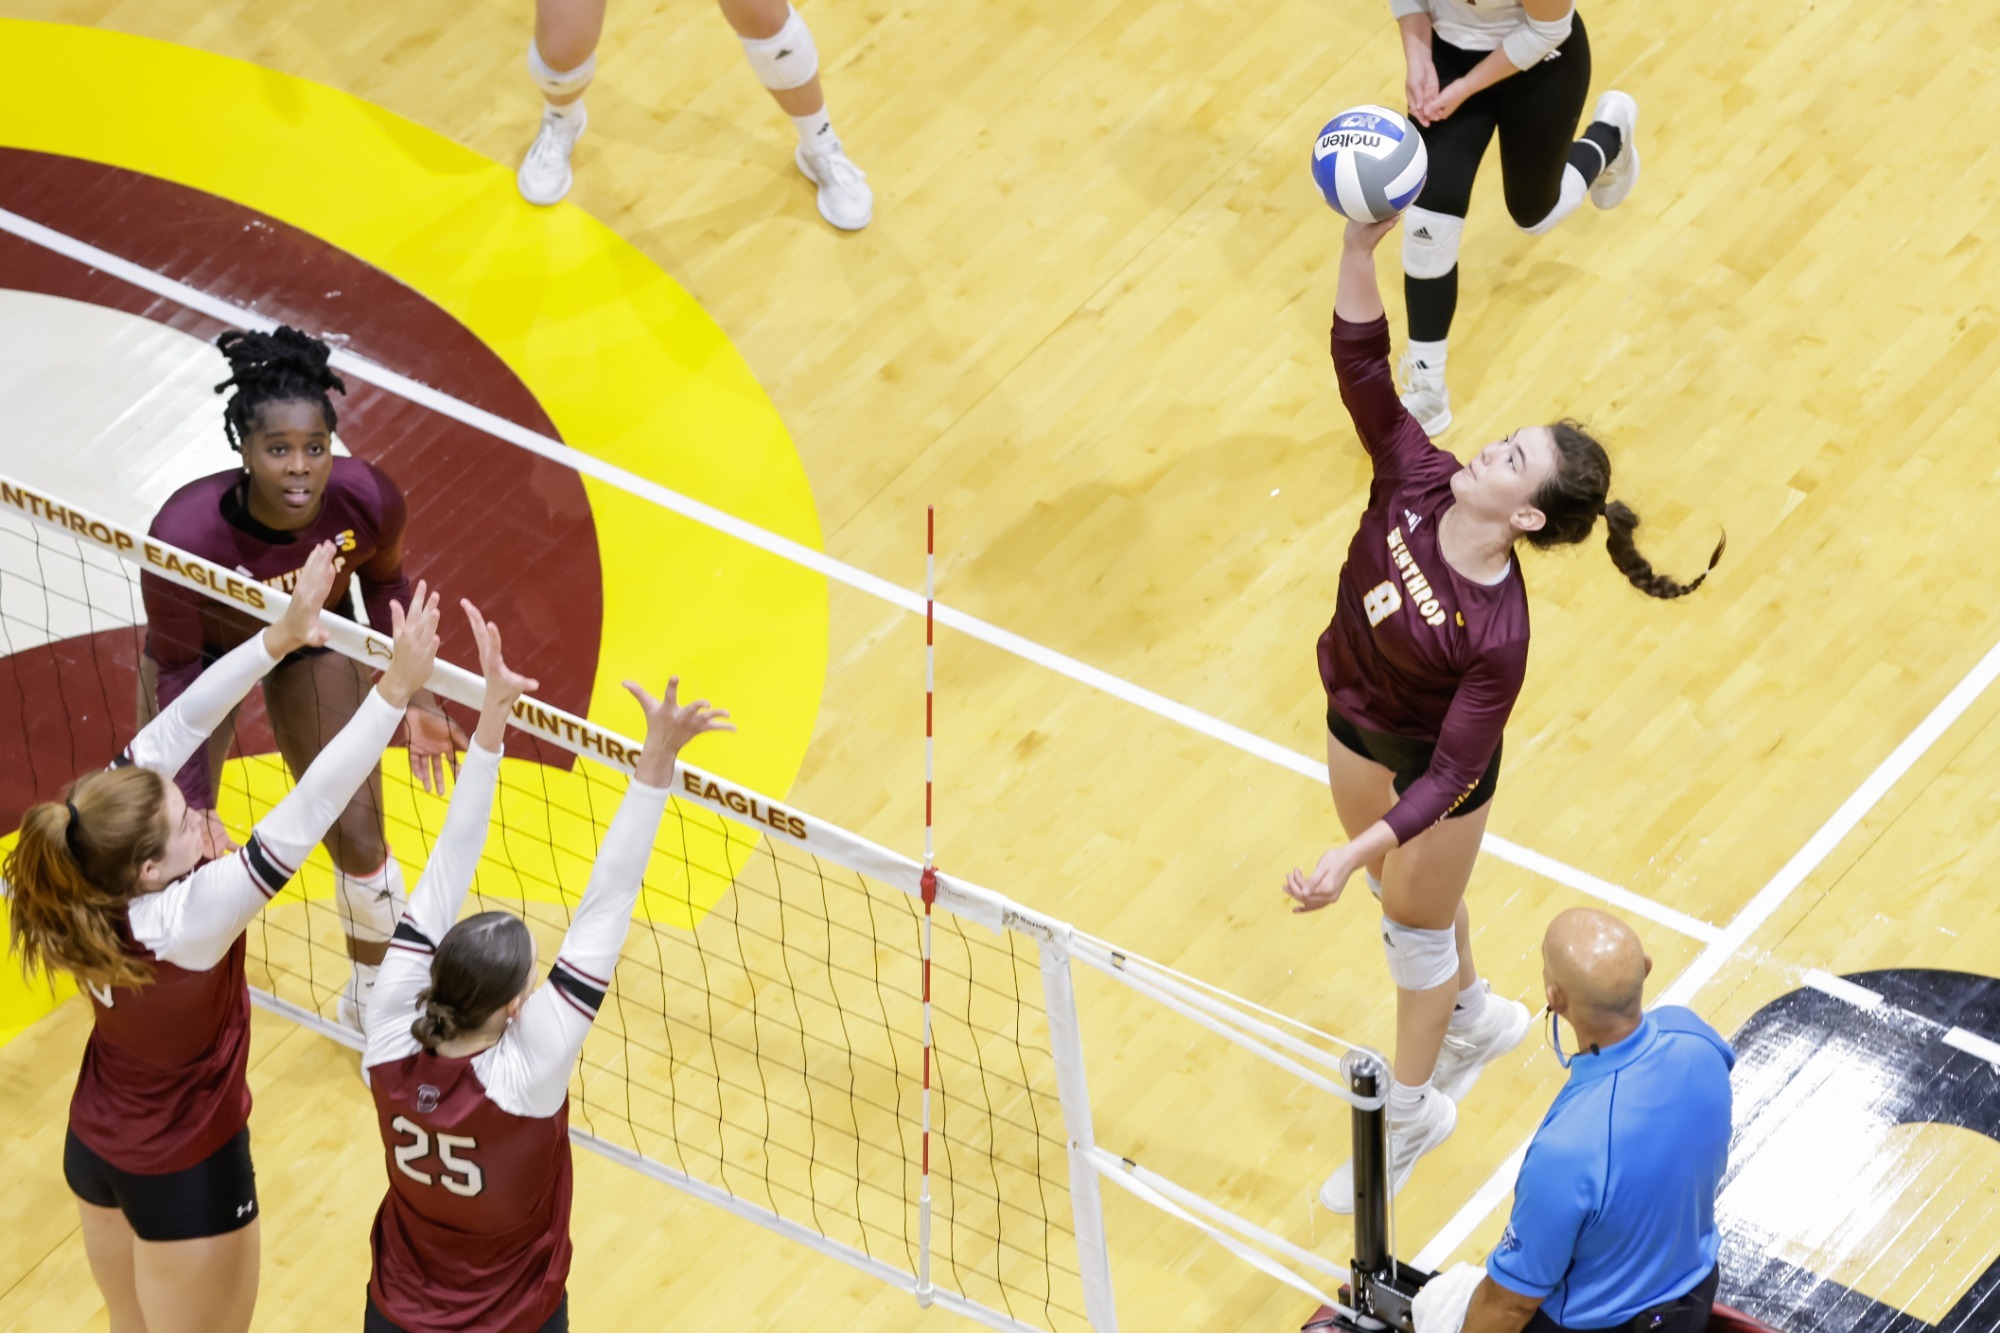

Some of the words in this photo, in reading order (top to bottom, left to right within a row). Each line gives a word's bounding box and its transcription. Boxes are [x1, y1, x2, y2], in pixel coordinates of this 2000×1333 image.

[1322, 134, 1381, 148] molten
[0, 481, 134, 551] NTHROP
[144, 543, 266, 609] EAGLES
[1387, 526, 1446, 627] WINTHROP
[1363, 580, 1402, 627] 8
[683, 771, 808, 840] EAGLES
[392, 1115, 483, 1197] 25
